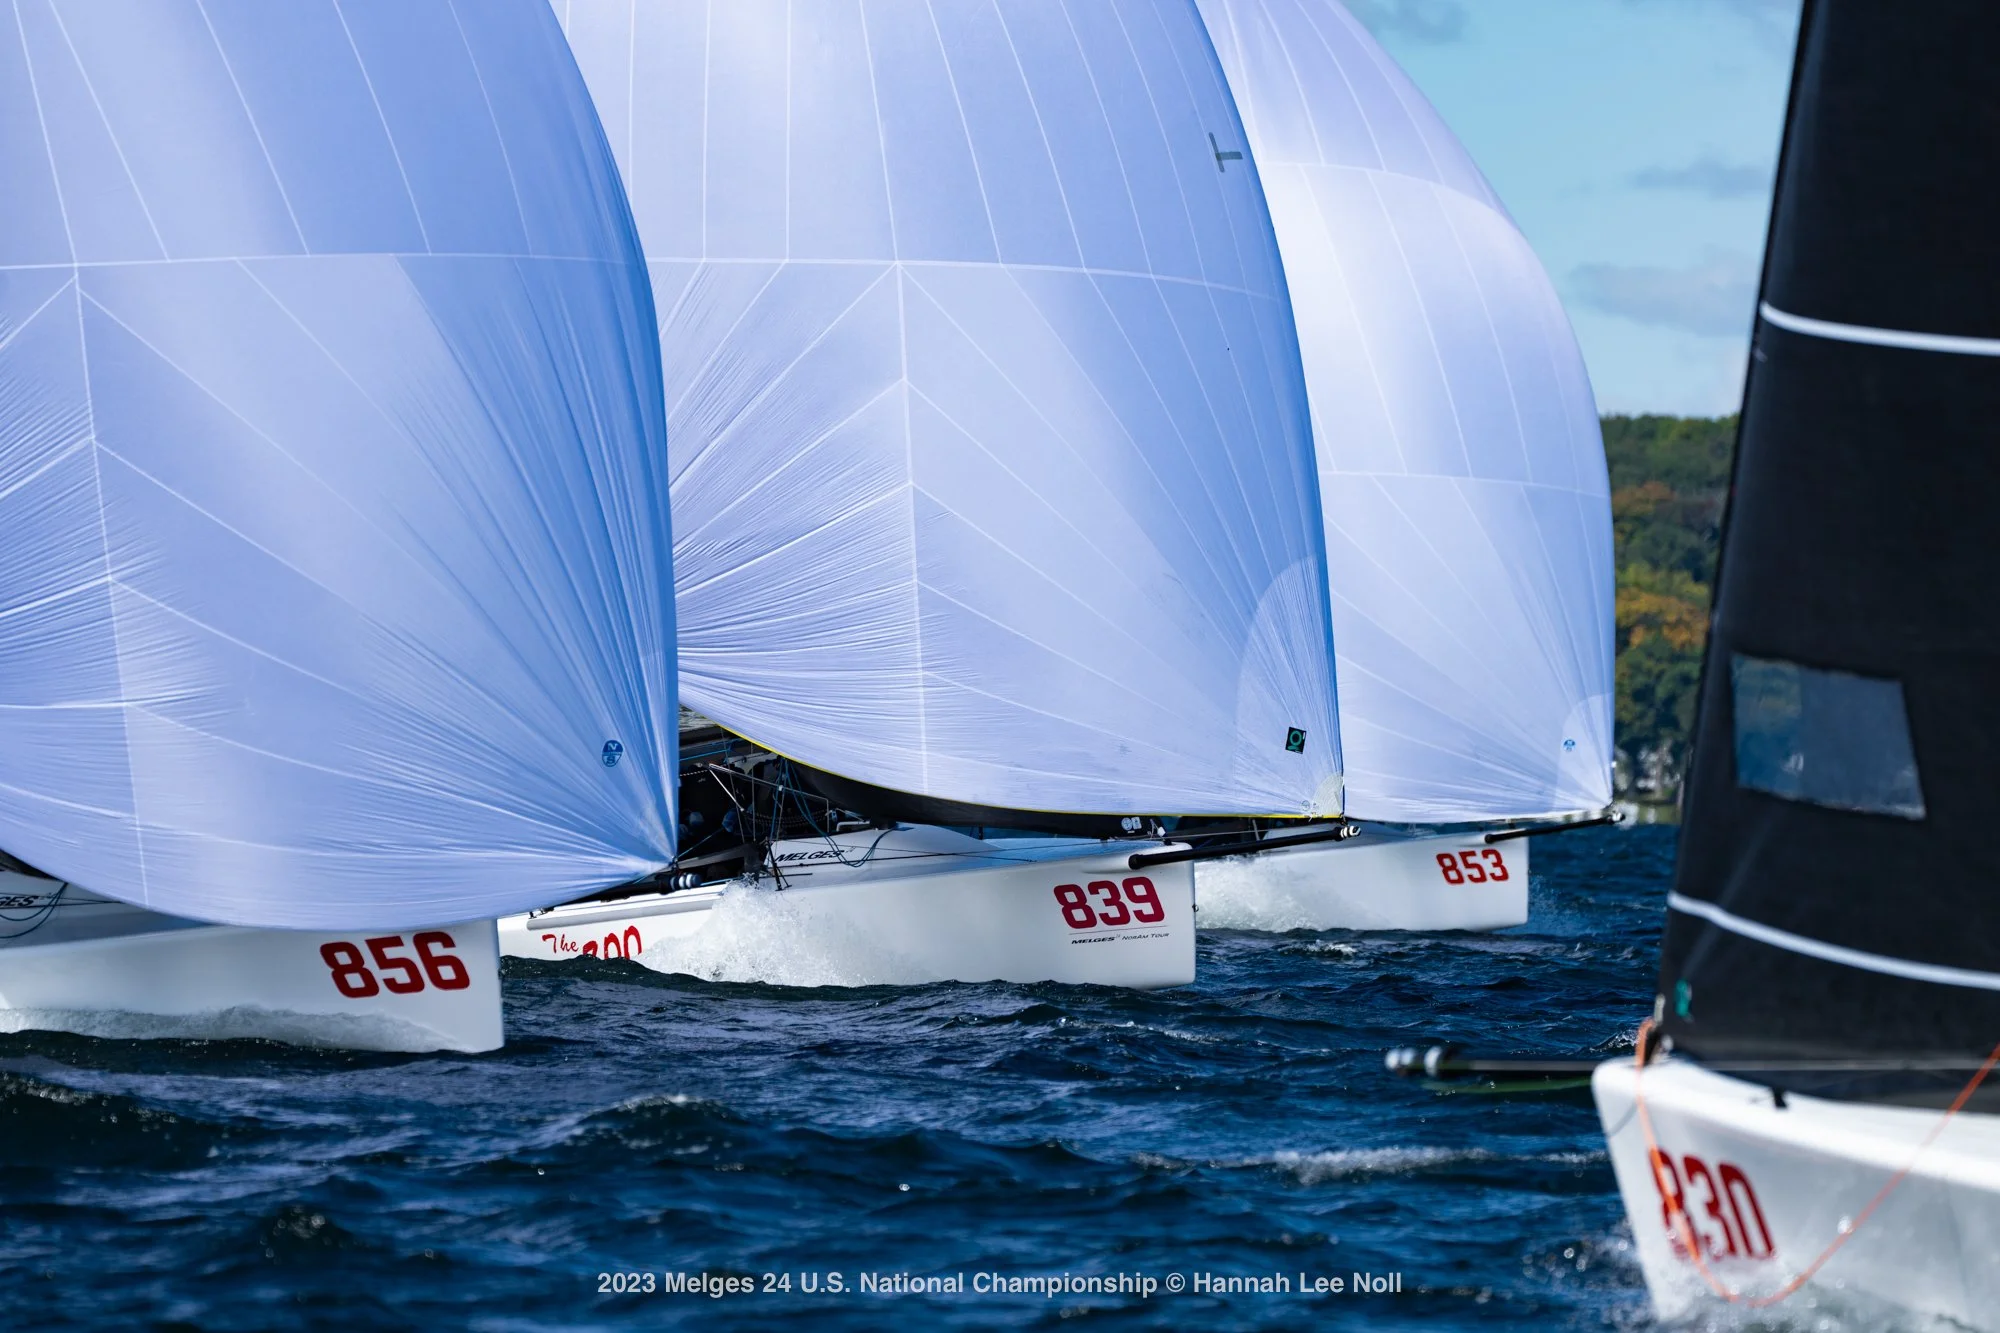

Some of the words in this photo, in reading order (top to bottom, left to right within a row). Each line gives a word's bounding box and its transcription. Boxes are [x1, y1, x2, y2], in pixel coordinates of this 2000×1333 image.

[775, 850, 844, 861] MELGES
[1436, 848, 1509, 885] 853
[1053, 876, 1165, 929] 839
[541, 933, 579, 954] The
[1071, 936, 1116, 945] MELGES
[320, 931, 470, 998] 856
[1648, 1147, 1776, 1263] 830
